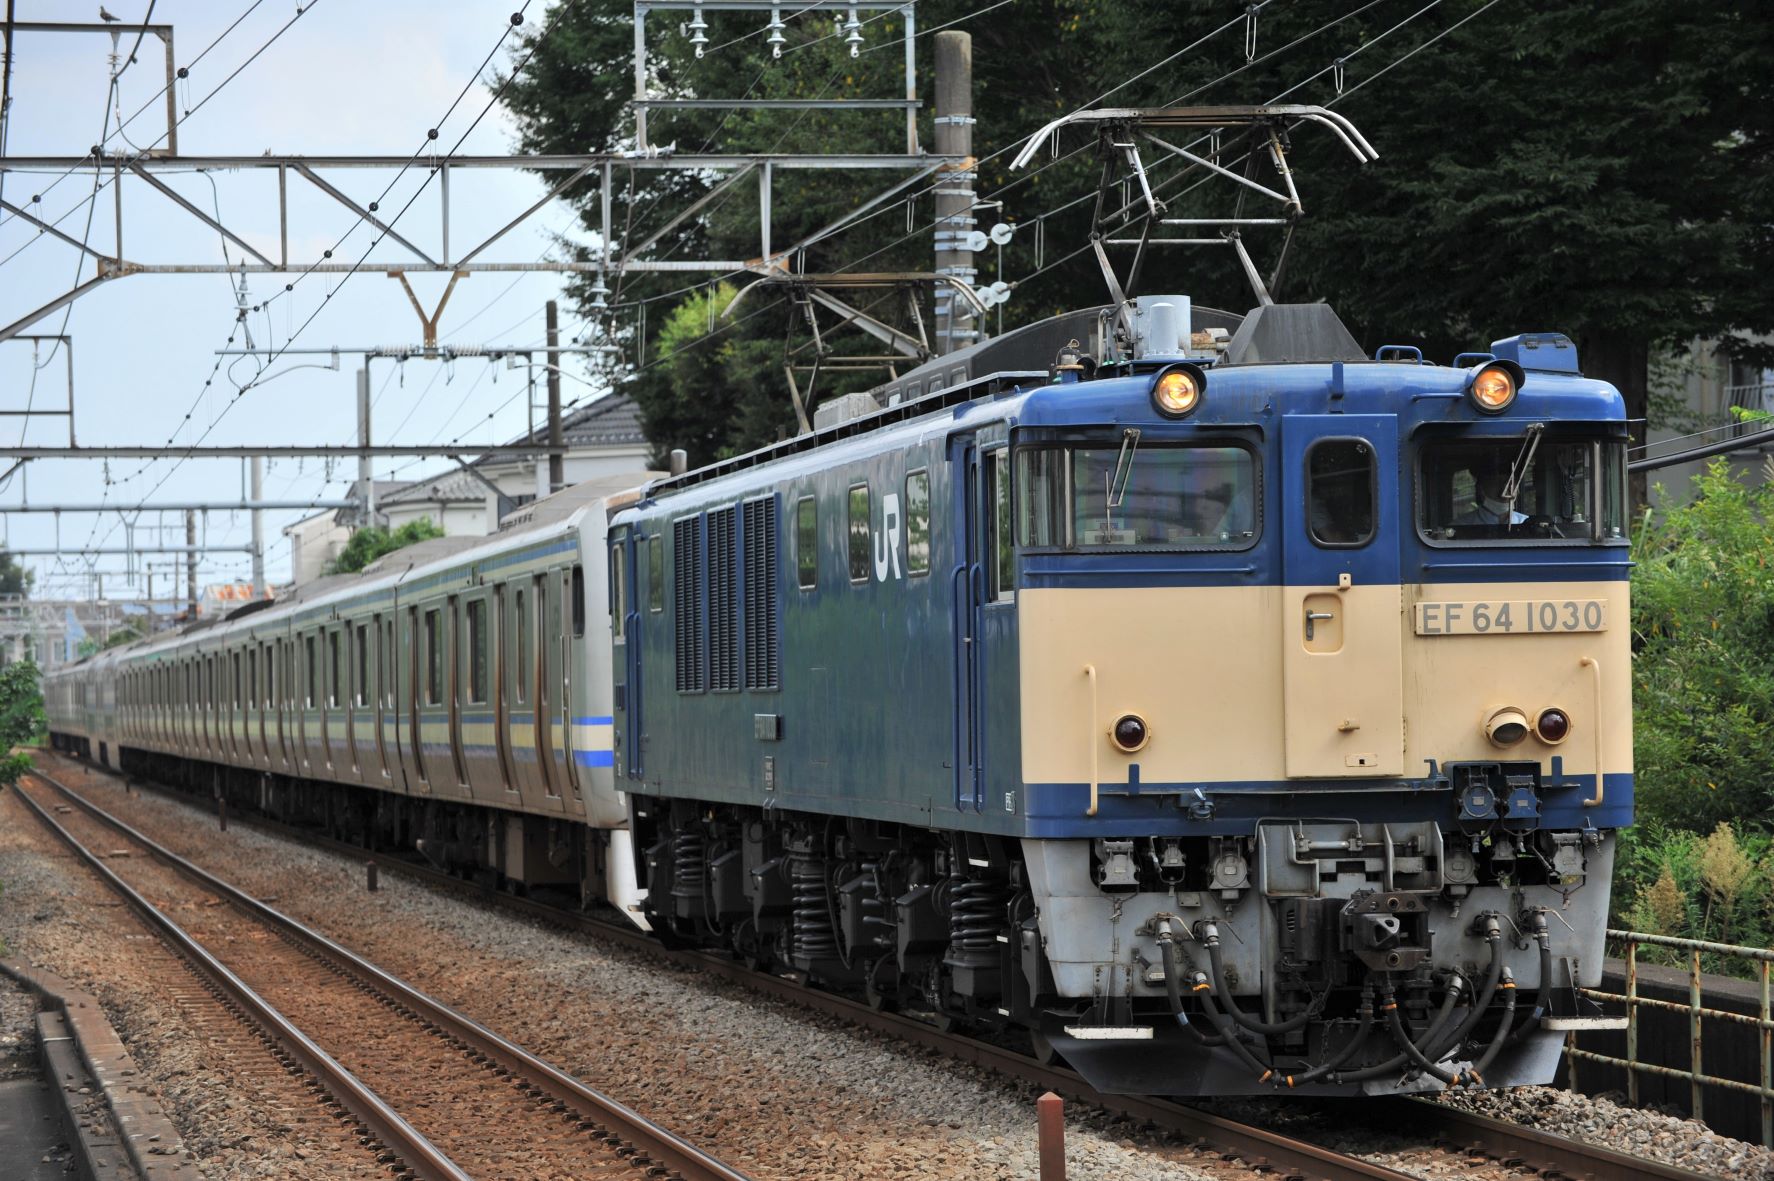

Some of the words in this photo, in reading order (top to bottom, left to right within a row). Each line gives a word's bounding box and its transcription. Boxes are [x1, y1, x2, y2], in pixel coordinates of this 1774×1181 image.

[874, 493, 902, 583] JR
[1423, 603, 1464, 633] EF
[1472, 602, 1513, 633] 64
[1526, 601, 1602, 632] 1030
